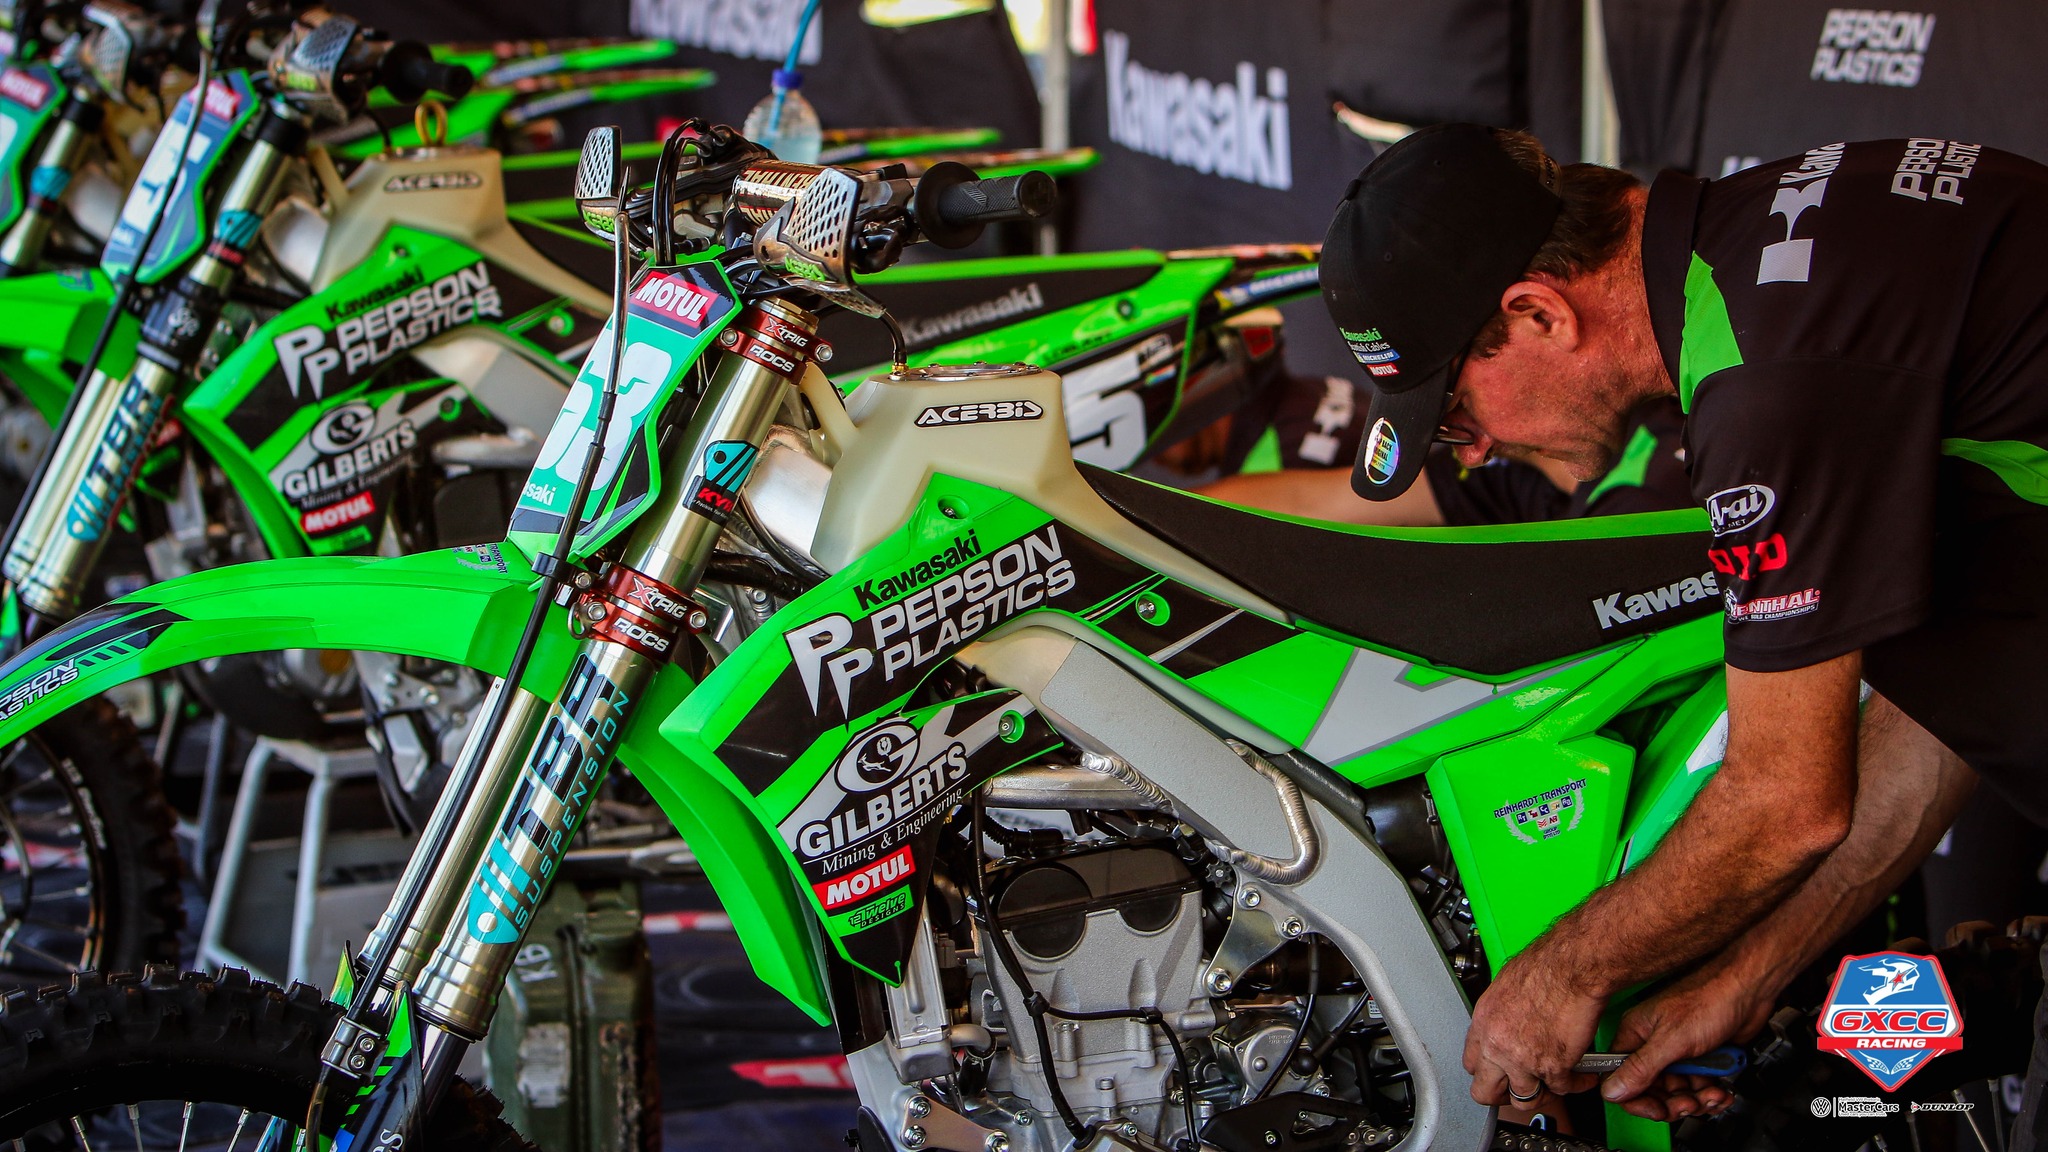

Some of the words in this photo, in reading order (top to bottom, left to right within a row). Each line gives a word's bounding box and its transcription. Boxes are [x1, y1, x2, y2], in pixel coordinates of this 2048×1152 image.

[1819, 9, 1936, 51] PEPSON
[1810, 47, 1925, 87] PLASTICS
[1104, 29, 1292, 190] Kawasaki
[325, 266, 425, 322] Kawasaki
[336, 261, 491, 354] PEPSON
[635, 277, 708, 323] MOTUL
[900, 282, 1044, 346] Kawasaki
[766, 316, 808, 348] XTRIG
[1340, 326, 1382, 342] Kawasaki
[749, 344, 796, 374] ROCS
[1369, 364, 1398, 376] MOTUL
[917, 401, 1043, 425] ACERBIS
[284, 421, 416, 497] GILBERTS
[304, 498, 372, 532] MOTUL
[1711, 485, 1763, 527] Arai
[853, 528, 983, 611] Kawasaki
[871, 525, 1063, 650] PEPSON
[627, 576, 688, 619] XTRIG
[612, 617, 669, 652] ROCS
[883, 560, 1077, 682] PLASTICS
[516, 690, 630, 930] SUSPENSION
[800, 744, 967, 857] GILBERTS
[1493, 795, 1538, 818] REINHARDT
[1540, 778, 1586, 801] TRANSPORT
[821, 842, 876, 876] Mining
[896, 787, 963, 842] Engineering
[827, 852, 910, 905] MOTUL
[861, 902, 905, 927] DESIGNS
